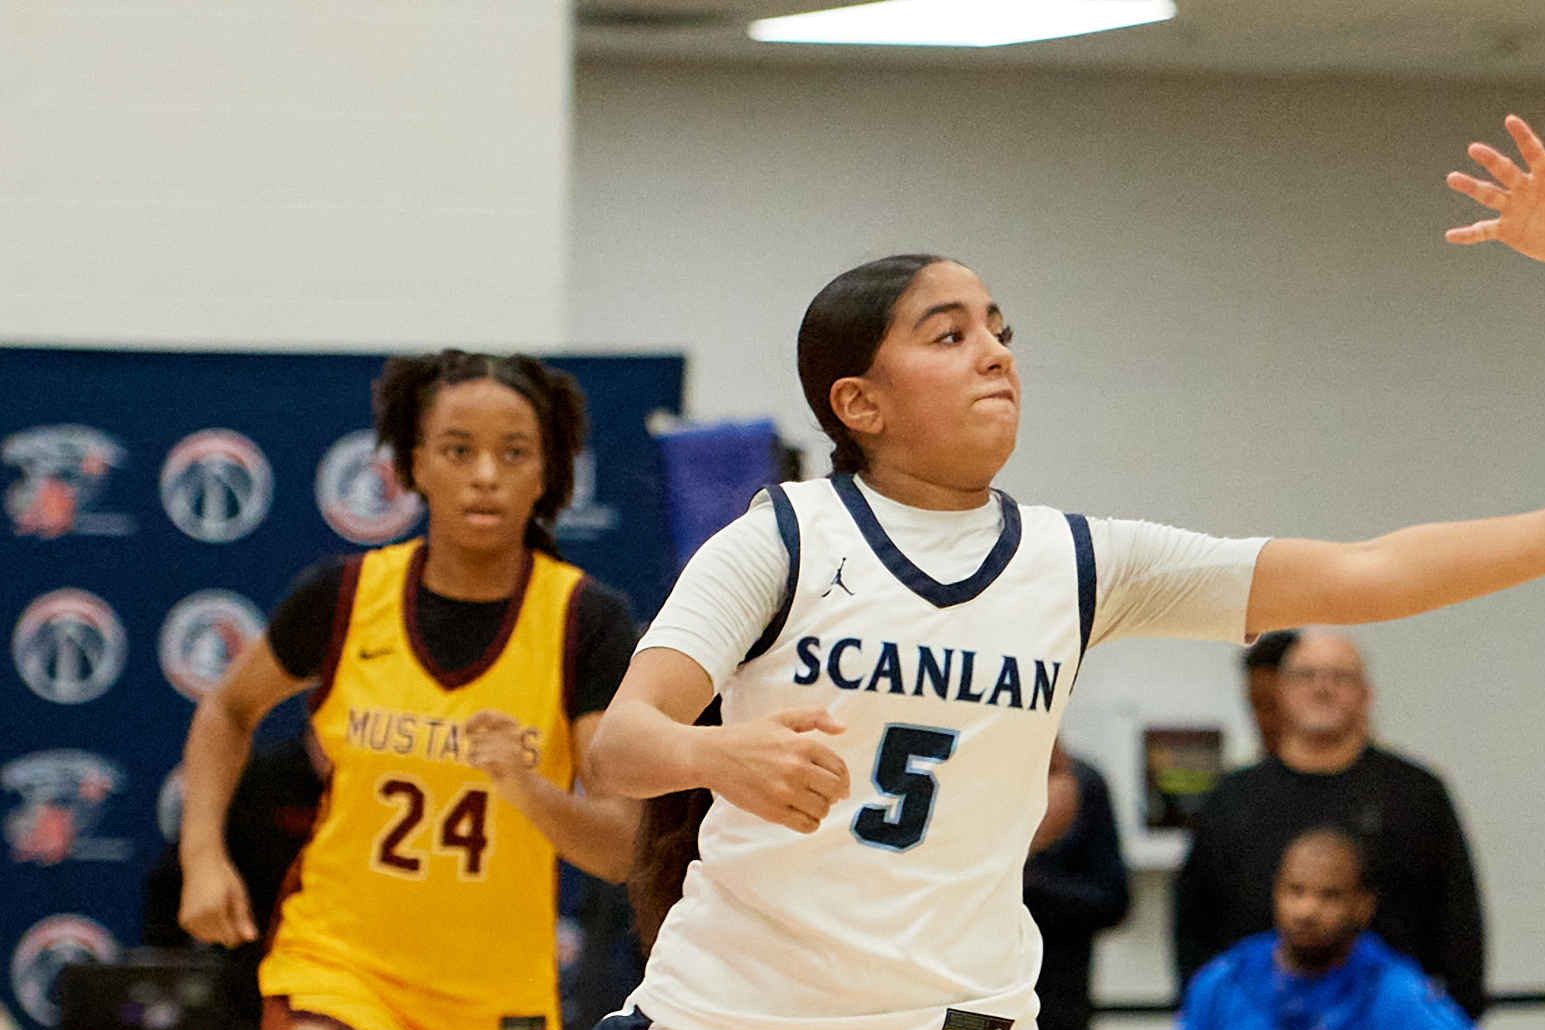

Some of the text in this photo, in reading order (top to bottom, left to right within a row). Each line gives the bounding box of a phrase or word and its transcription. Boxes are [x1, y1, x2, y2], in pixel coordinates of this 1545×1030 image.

[792, 635, 1062, 714] SCANLAN
[346, 706, 542, 771] MUSTAS
[369, 770, 498, 882] 24
[850, 721, 961, 854] 5
